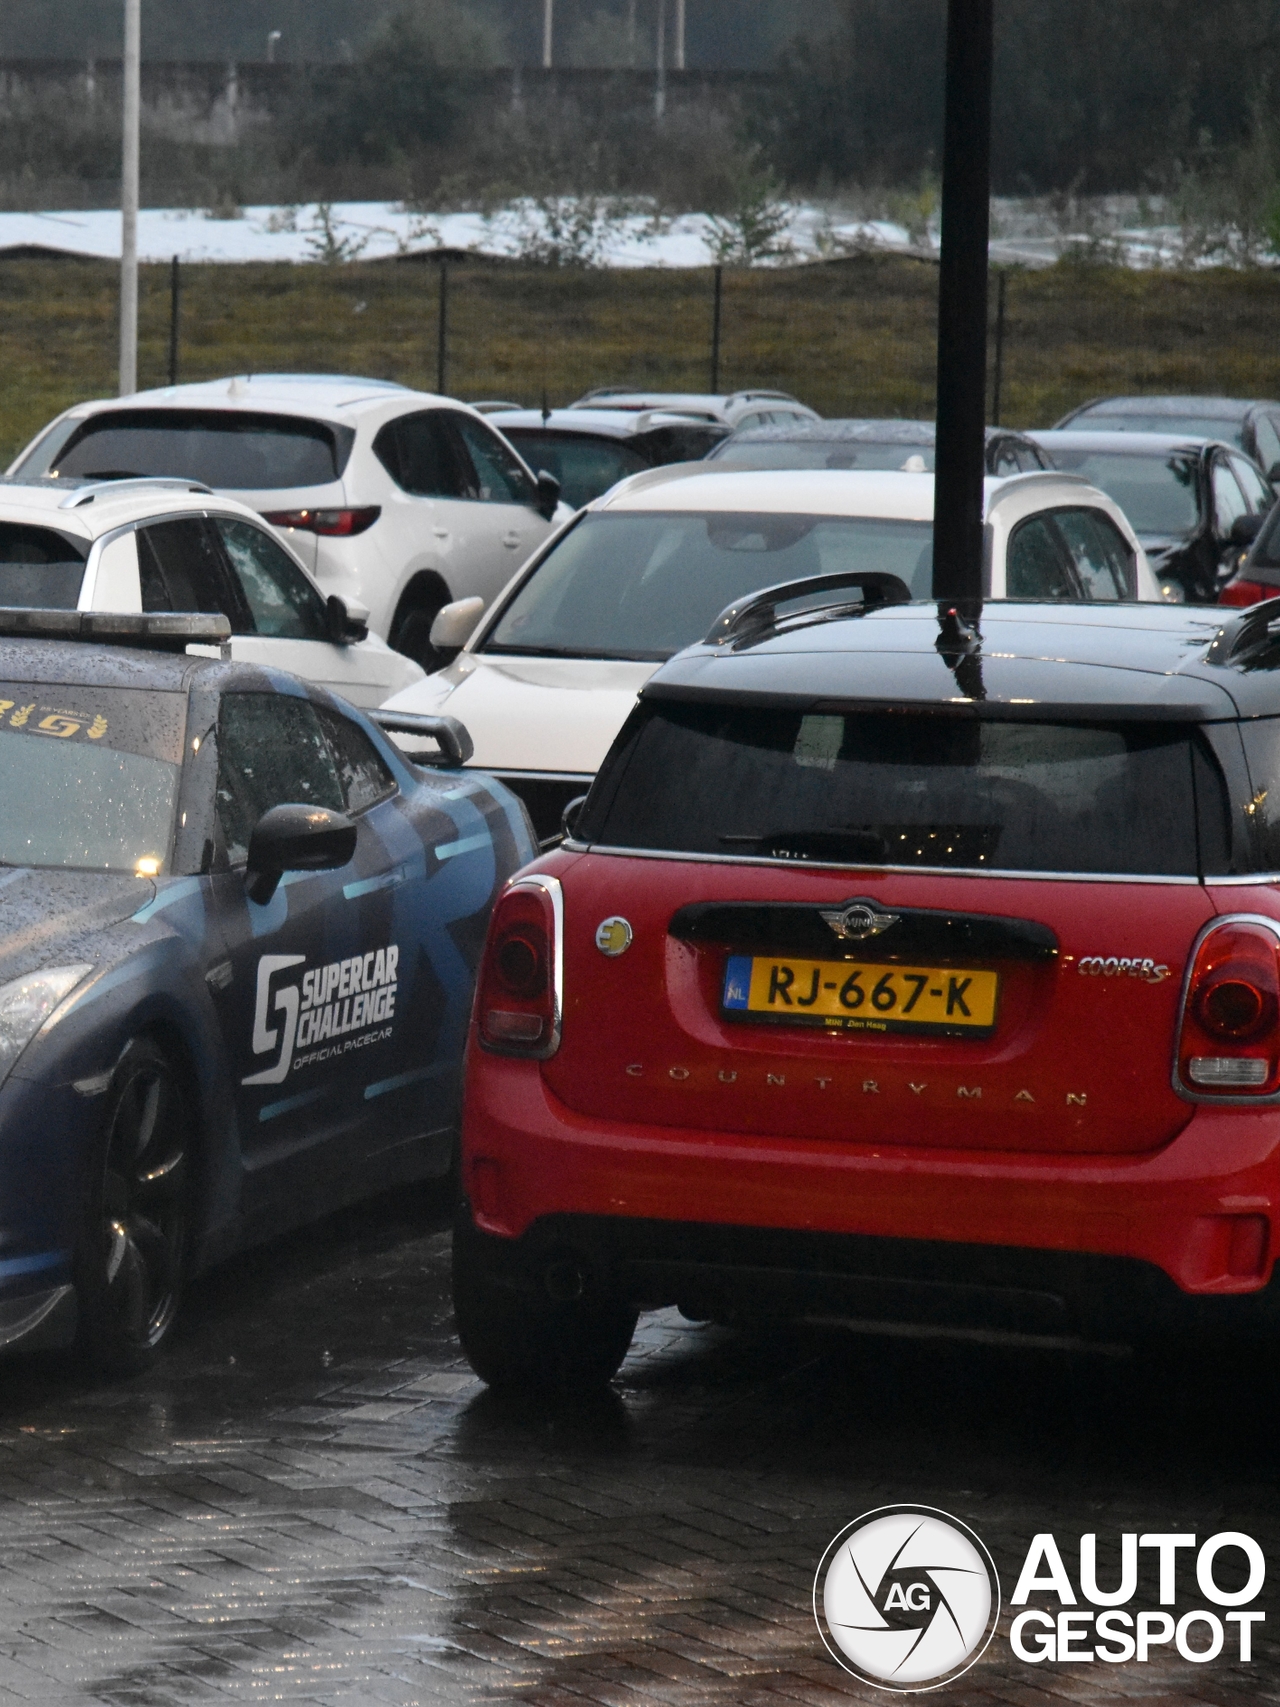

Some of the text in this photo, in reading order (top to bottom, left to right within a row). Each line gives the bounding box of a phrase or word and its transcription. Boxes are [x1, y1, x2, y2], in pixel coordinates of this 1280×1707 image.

[845, 917, 870, 927] MINI
[301, 944, 399, 1011] SUPERCAR
[768, 965, 973, 1017] RJ-667-K
[1078, 956, 1168, 984] COOPER S
[296, 983, 397, 1048] CHALLENGE
[727, 987, 746, 1001] NL
[825, 1018, 842, 1027] MINI
[293, 1026, 393, 1070] OFFICIAL PACECAR
[625, 1064, 1088, 1107] COUNTRYMAN
